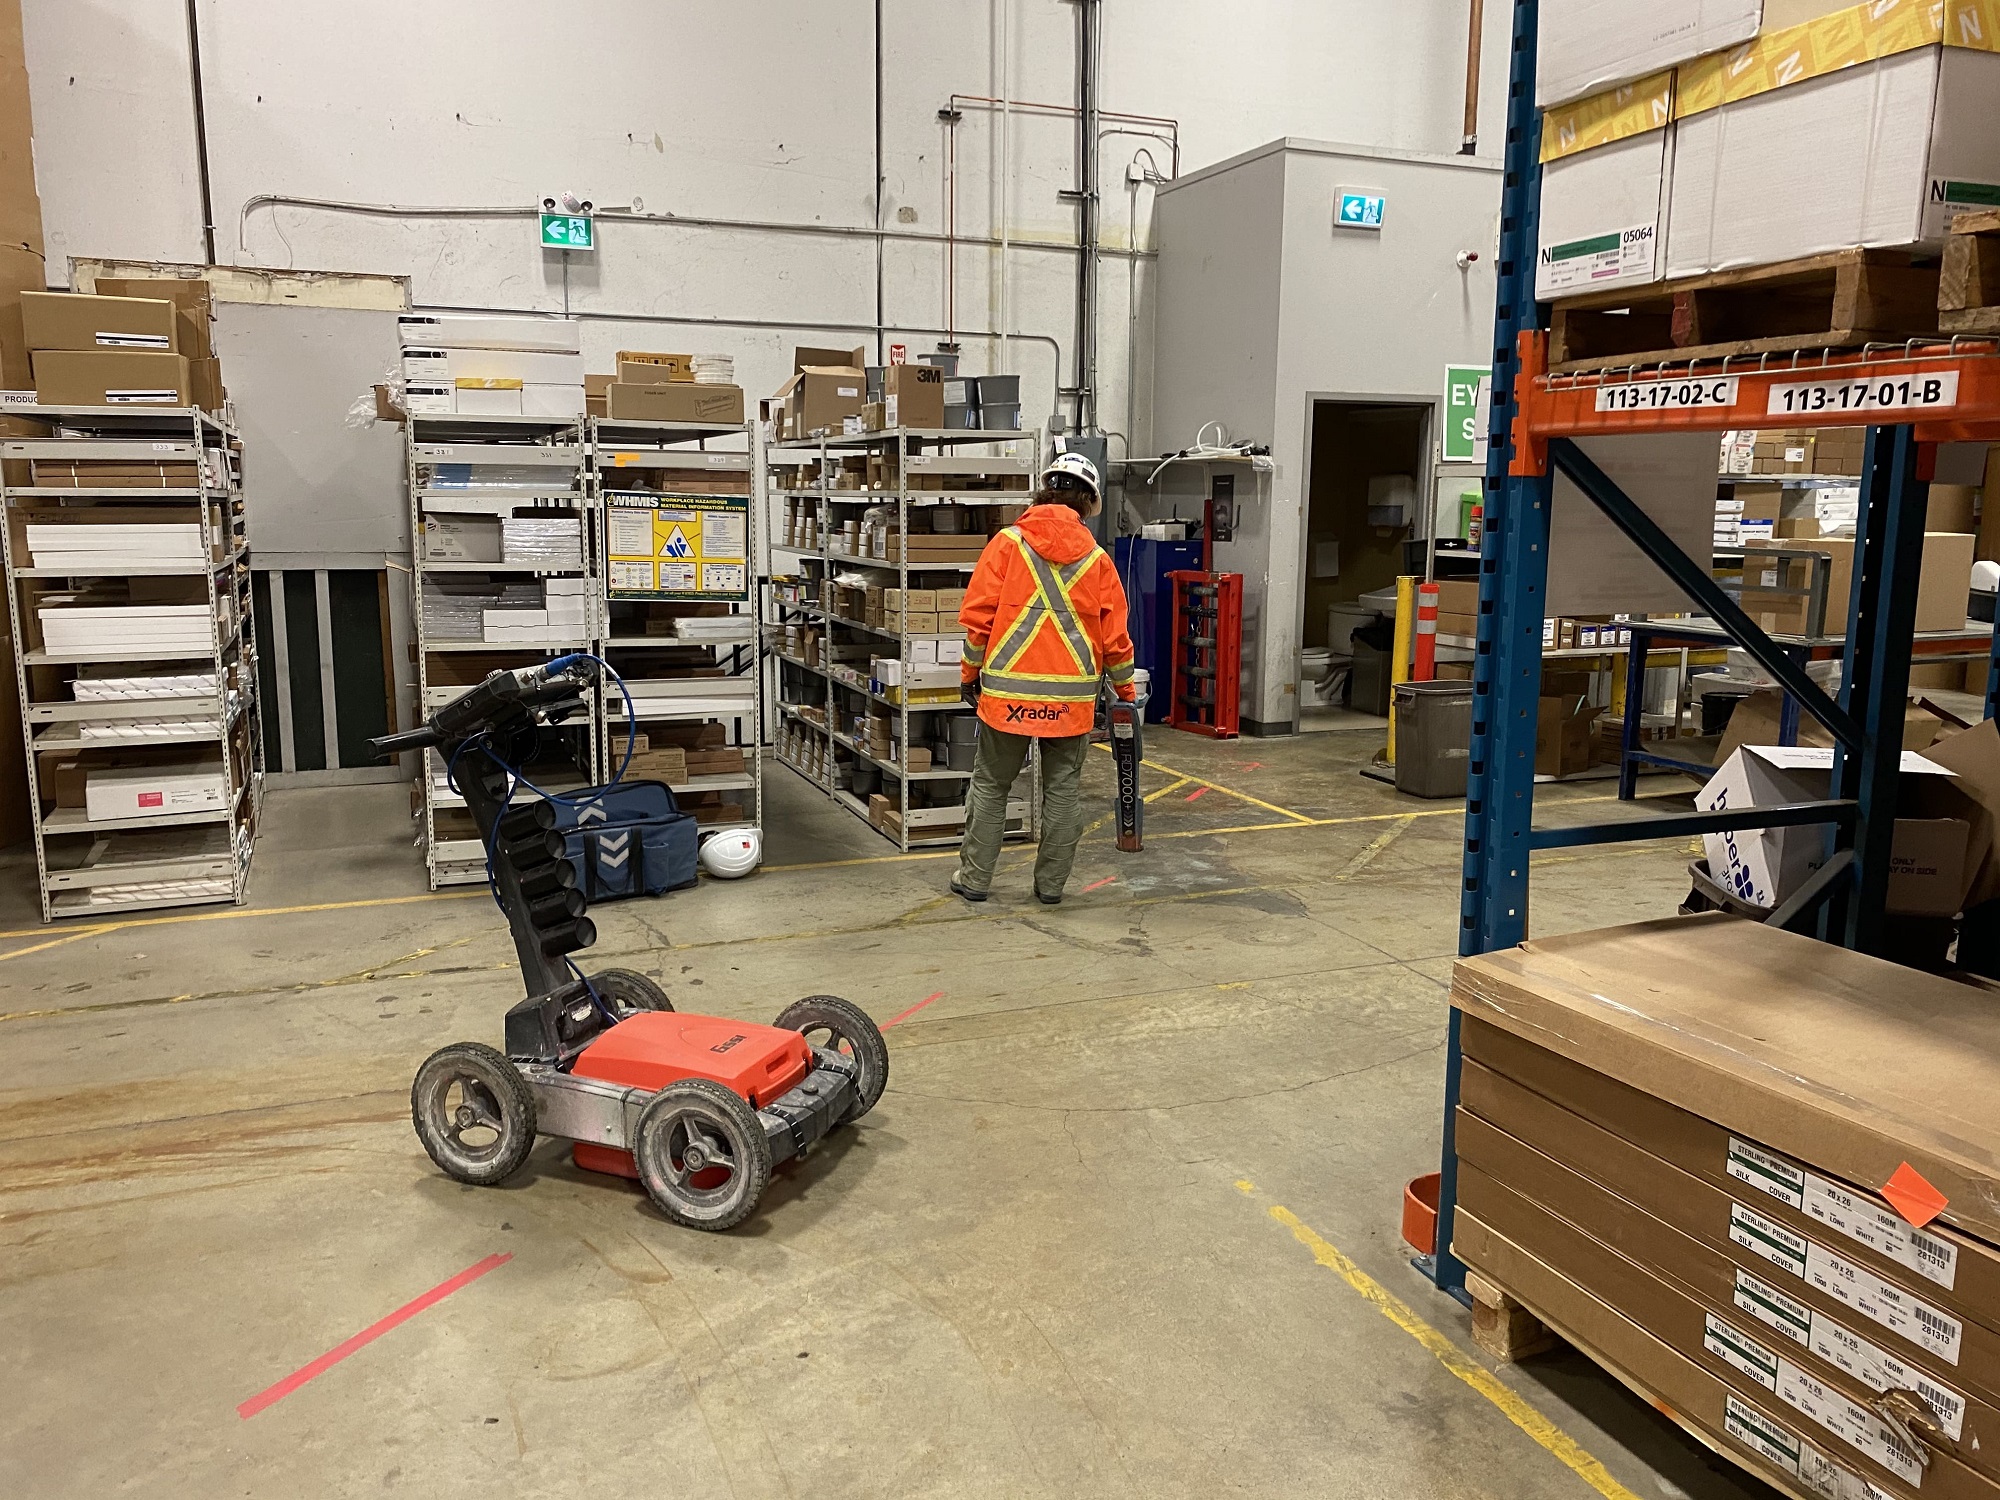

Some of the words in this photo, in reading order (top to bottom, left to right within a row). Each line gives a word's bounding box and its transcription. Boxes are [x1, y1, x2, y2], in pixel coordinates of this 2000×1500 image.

[1624, 226, 1652, 243] 05064
[916, 369, 940, 384] 3M
[1606, 382, 1727, 408] 113-17-02-C
[1782, 380, 1942, 411] 113-17-01-B
[614, 496, 659, 508] WHMIS
[1006, 704, 1063, 723] Xradar
[1770, 1160, 1798, 1180] PREMIUM
[1736, 1169, 1750, 1182] SILK
[1769, 1186, 1790, 1202] COVER
[1828, 1189, 1835, 1199] 20
[1842, 1196, 1851, 1207] 26
[1830, 1216, 1845, 1228] LONG
[1856, 1229, 1875, 1243] WHITE
[1877, 1214, 1896, 1229] 160M
[1773, 1229, 1800, 1248] PREMIUM
[1738, 1236, 1753, 1248] SILK
[1772, 1254, 1793, 1271] COVER
[1918, 1250, 1946, 1269] 281313
[1831, 1260, 1839, 1269] 20
[1846, 1268, 1854, 1278] 26
[1833, 1287, 1848, 1299] LONG
[1858, 1301, 1877, 1315] WHITE
[1880, 1287, 1900, 1302] 160M
[1776, 1296, 1804, 1317] PREMIUM
[1743, 1301, 1756, 1314] SILK
[1776, 1321, 1797, 1338] COVER
[1834, 1330, 1842, 1339] 20
[1849, 1338, 1858, 1348] 26
[1922, 1324, 1950, 1344] 281313
[1745, 1341, 1771, 1362] PREMIUM
[1713, 1345, 1726, 1358] SILK
[1744, 1366, 1765, 1383] COVER
[1837, 1356, 1852, 1369] LONG
[1862, 1371, 1882, 1387] WHITE
[1884, 1360, 1903, 1376] 160M
[1800, 1376, 1807, 1386] 20
[1814, 1385, 1822, 1396] 26
[1802, 1402, 1816, 1416] LONG
[1826, 1418, 1844, 1434] WHITE
[1847, 1407, 1866, 1423] 160M
[1886, 1446, 1913, 1468] 281313
